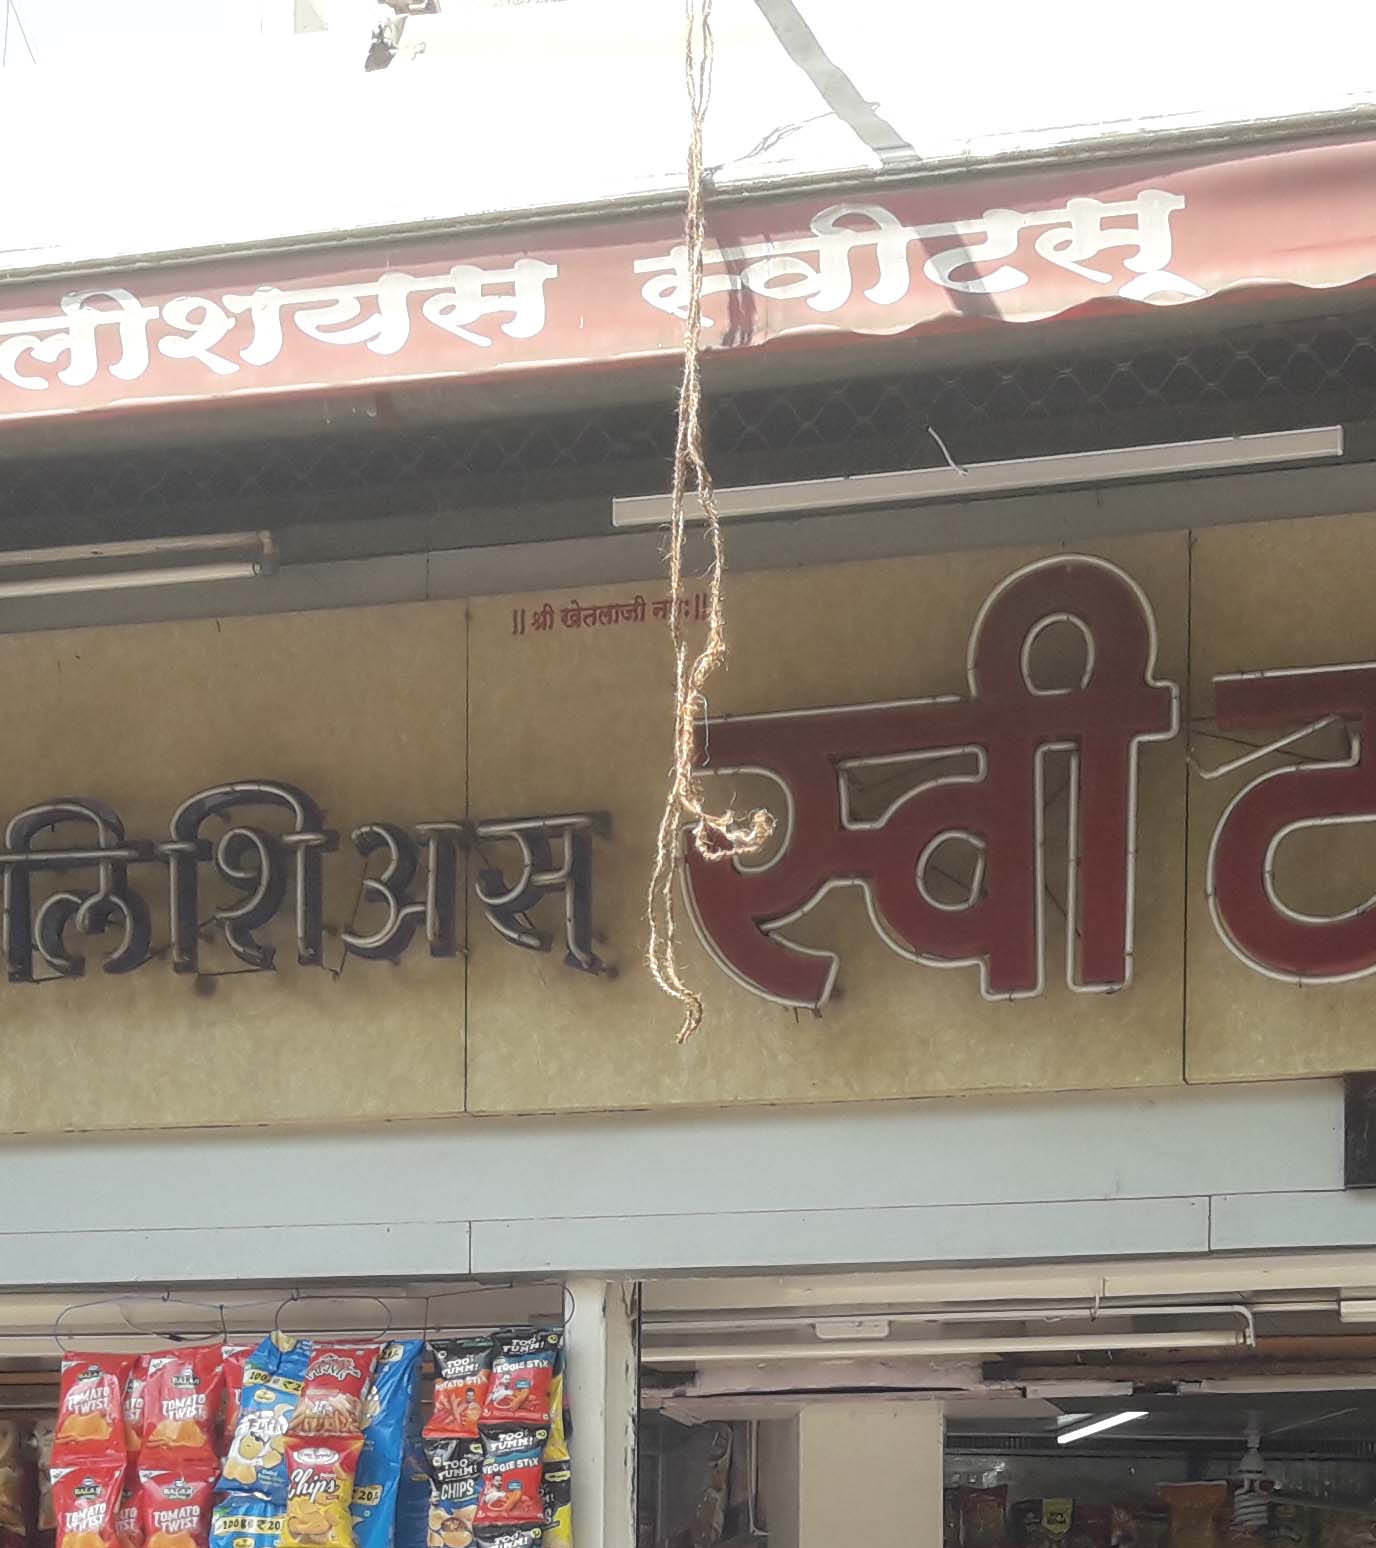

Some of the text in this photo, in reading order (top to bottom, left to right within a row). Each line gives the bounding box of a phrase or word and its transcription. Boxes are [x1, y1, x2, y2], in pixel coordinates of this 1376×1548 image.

[561, 595, 647, 629] खेतलाजी
[512, 1338, 536, 1347] TOO
[441, 1363, 479, 1377] YUMM!
[446, 1357, 470, 1368] TOO
[526, 1359, 549, 1369] STIX
[68, 1387, 110, 1411] TOMATO
[73, 1398, 110, 1415] TWIST
[160, 1394, 206, 1415] TOMATO
[169, 1405, 204, 1419] TWIST
[491, 1437, 533, 1451] YUMM!
[498, 1431, 524, 1442] TOO
[442, 1459, 468, 1469] TOO
[482, 1457, 539, 1475] VEGGIE STIX
[288, 1468, 338, 1504] Chips
[440, 1479, 474, 1501] CHIPS
[65, 1503, 106, 1528] TOMATO
[72, 1515, 105, 1531] TWIST
[153, 1505, 200, 1527] TOMATO
[162, 1517, 198, 1532] TWIST
[494, 1533, 518, 1545] TOO
